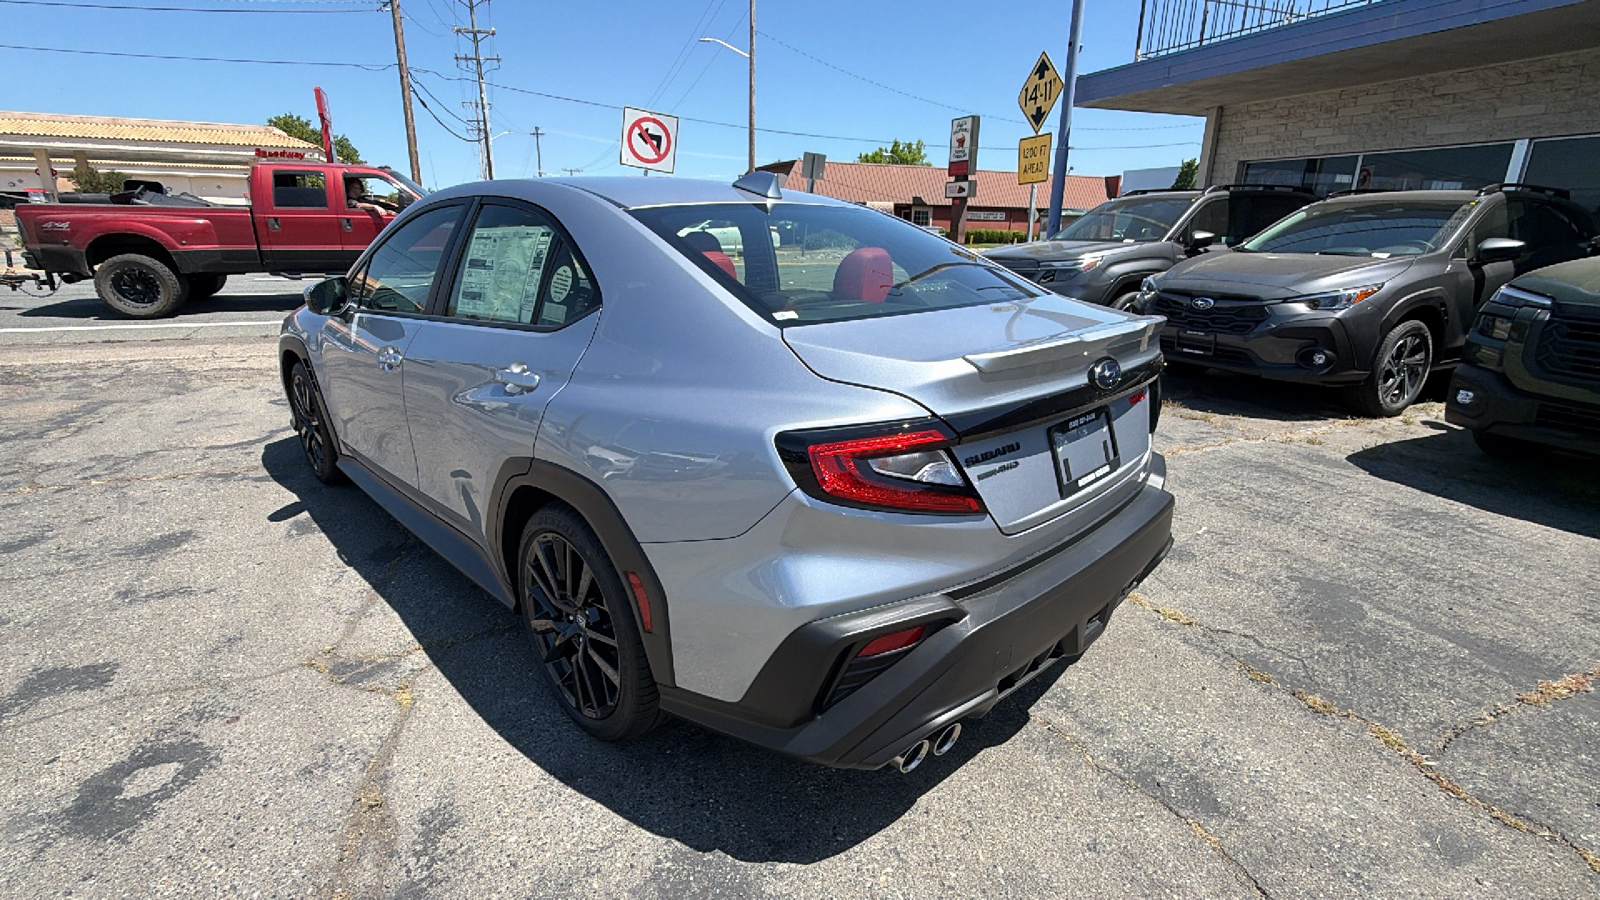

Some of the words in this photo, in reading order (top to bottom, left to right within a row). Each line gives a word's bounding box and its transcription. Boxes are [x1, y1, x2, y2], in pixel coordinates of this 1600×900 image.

[255, 147, 305, 160] Speedway
[1023, 146, 1038, 159] 1200
[1040, 144, 1047, 156] FT
[1023, 161, 1043, 175] AHEAD
[965, 442, 1020, 468] SUBARU
